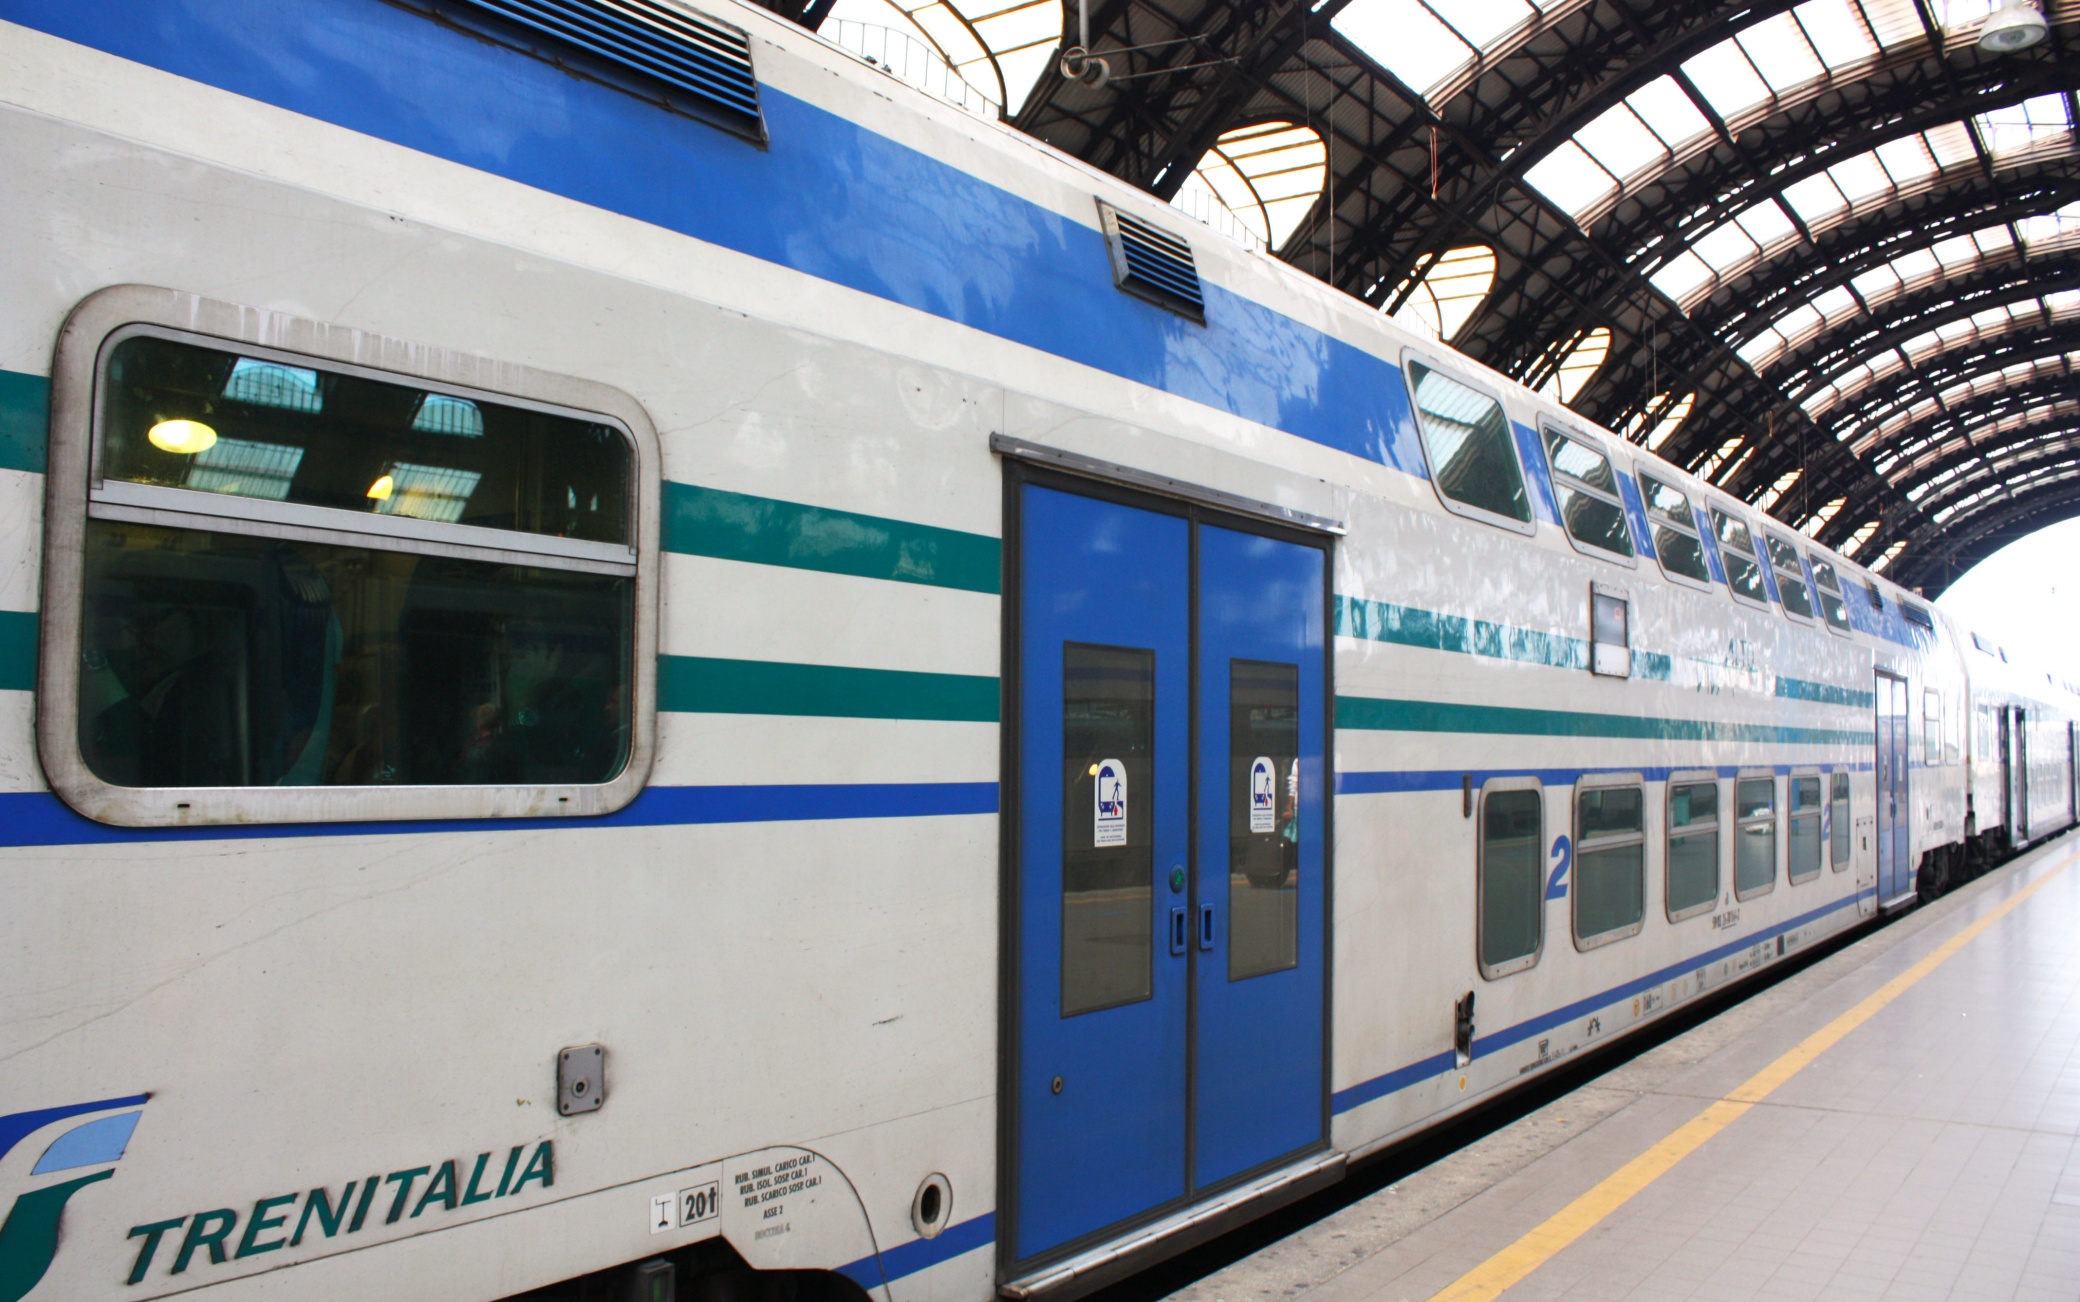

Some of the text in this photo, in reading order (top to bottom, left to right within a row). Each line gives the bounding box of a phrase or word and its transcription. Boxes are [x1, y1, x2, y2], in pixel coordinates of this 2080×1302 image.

[1545, 834, 1571, 900] 2
[735, 1171, 750, 1185] RUB.
[775, 1158, 798, 1173] CARICO
[740, 1183, 755, 1196] RUB.
[744, 1194, 760, 1208] RUB.
[760, 1186, 788, 1203] SCARICO
[126, 1139, 555, 1286] TRENITALIA
[763, 1206, 778, 1220] ASSE
